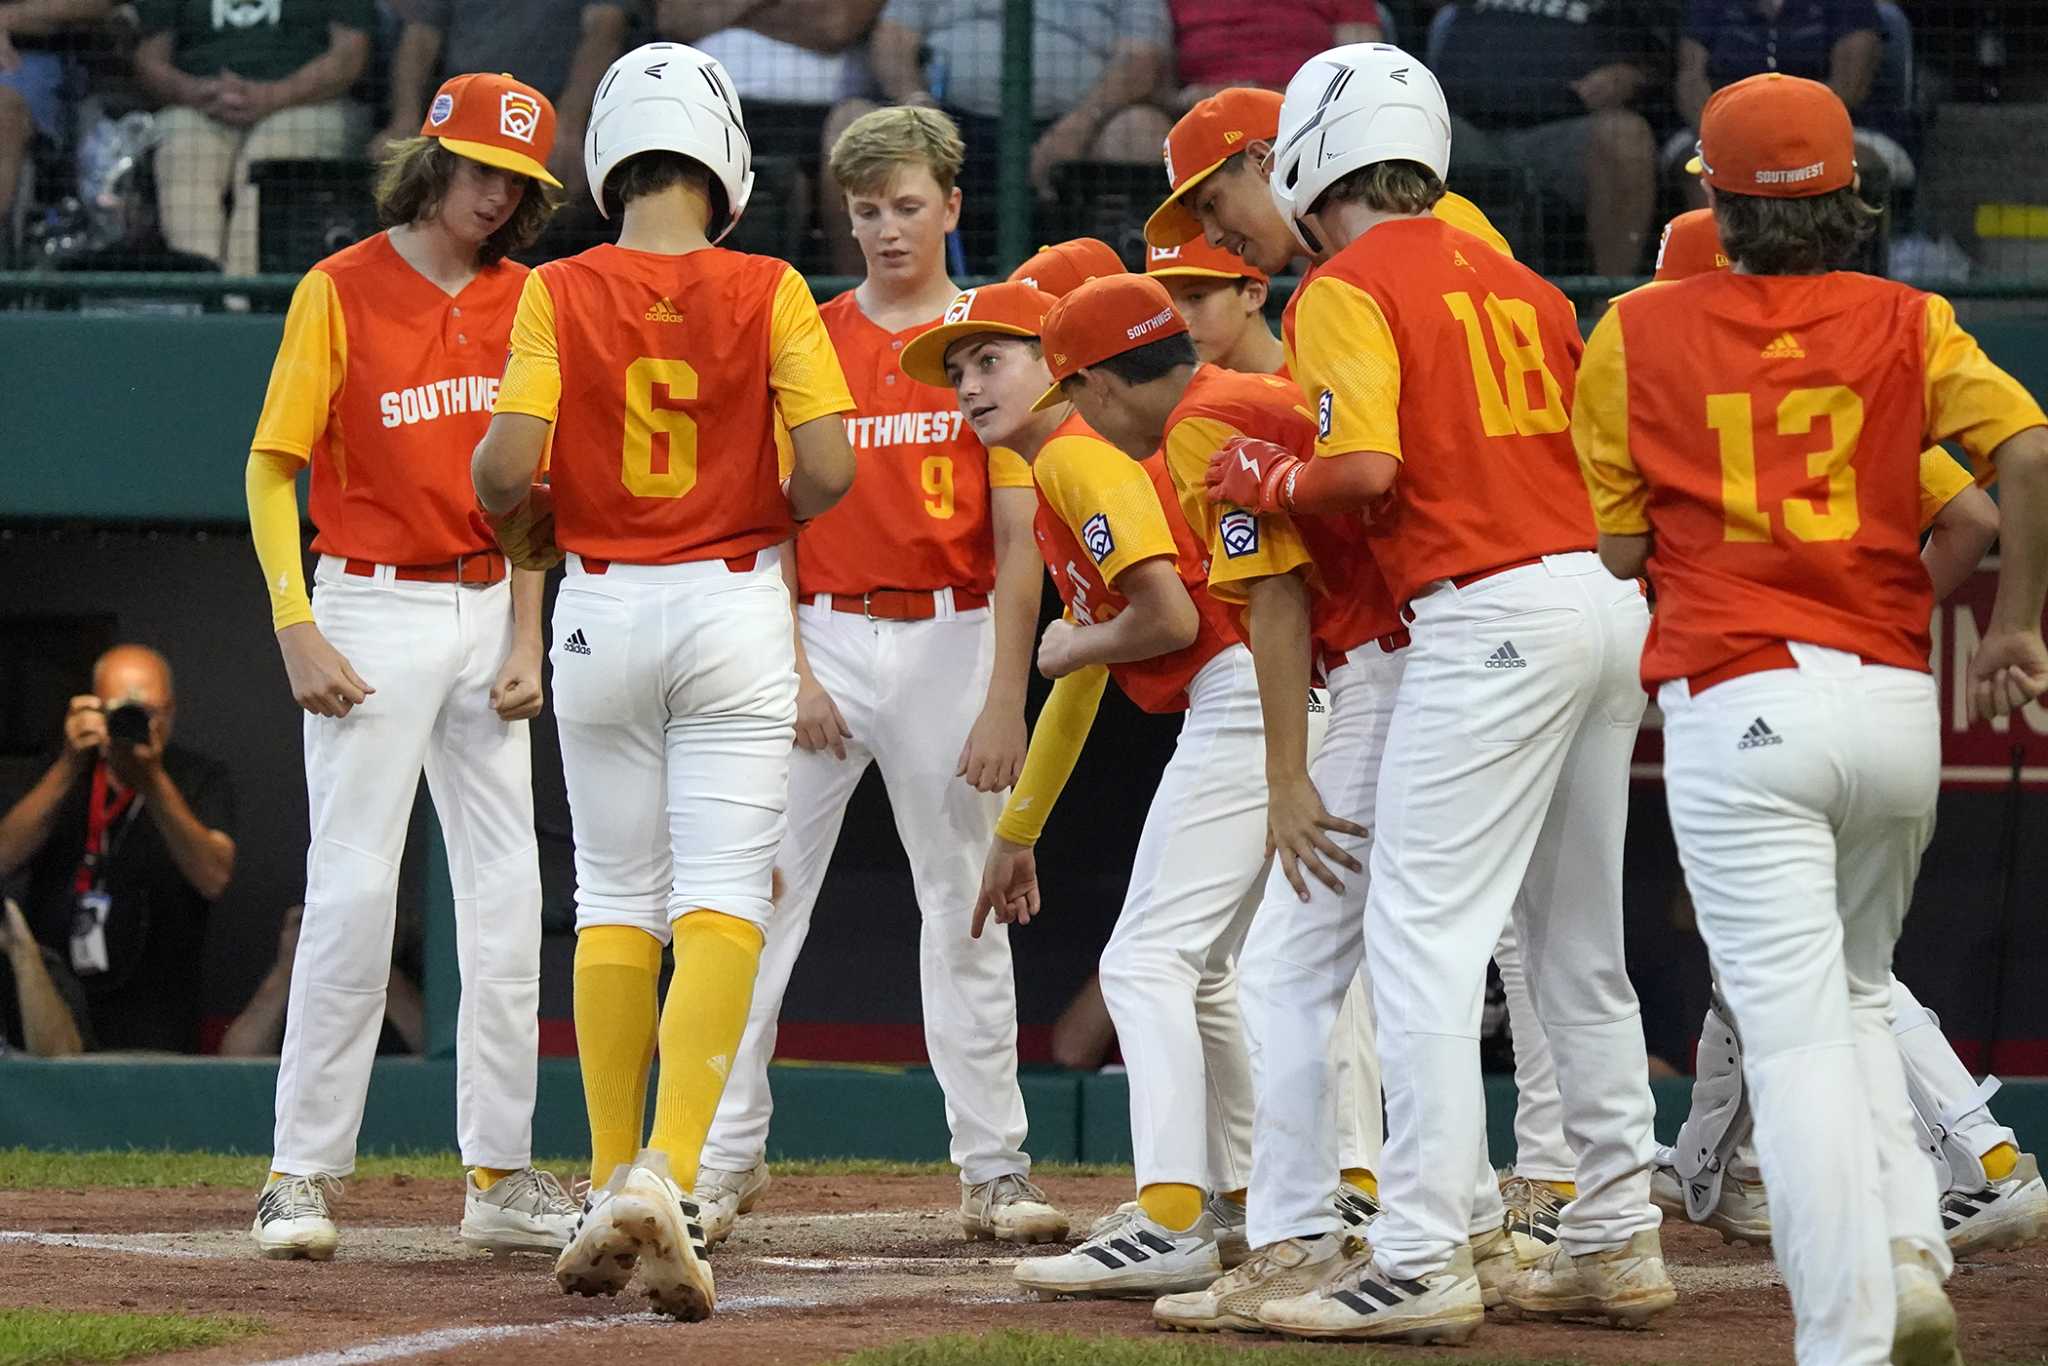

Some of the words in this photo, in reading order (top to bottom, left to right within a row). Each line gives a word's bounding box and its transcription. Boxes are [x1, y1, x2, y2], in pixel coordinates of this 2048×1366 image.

[1754, 162, 1825, 183] SOUTHWEST
[645, 311, 684, 323] adidas
[1127, 306, 1175, 340] SOUTHWEST
[1442, 291, 1570, 437] 18
[621, 357, 698, 499] 6
[921, 455, 954, 519] 9
[1706, 385, 1864, 543] 13
[1484, 657, 1528, 669] adidas
